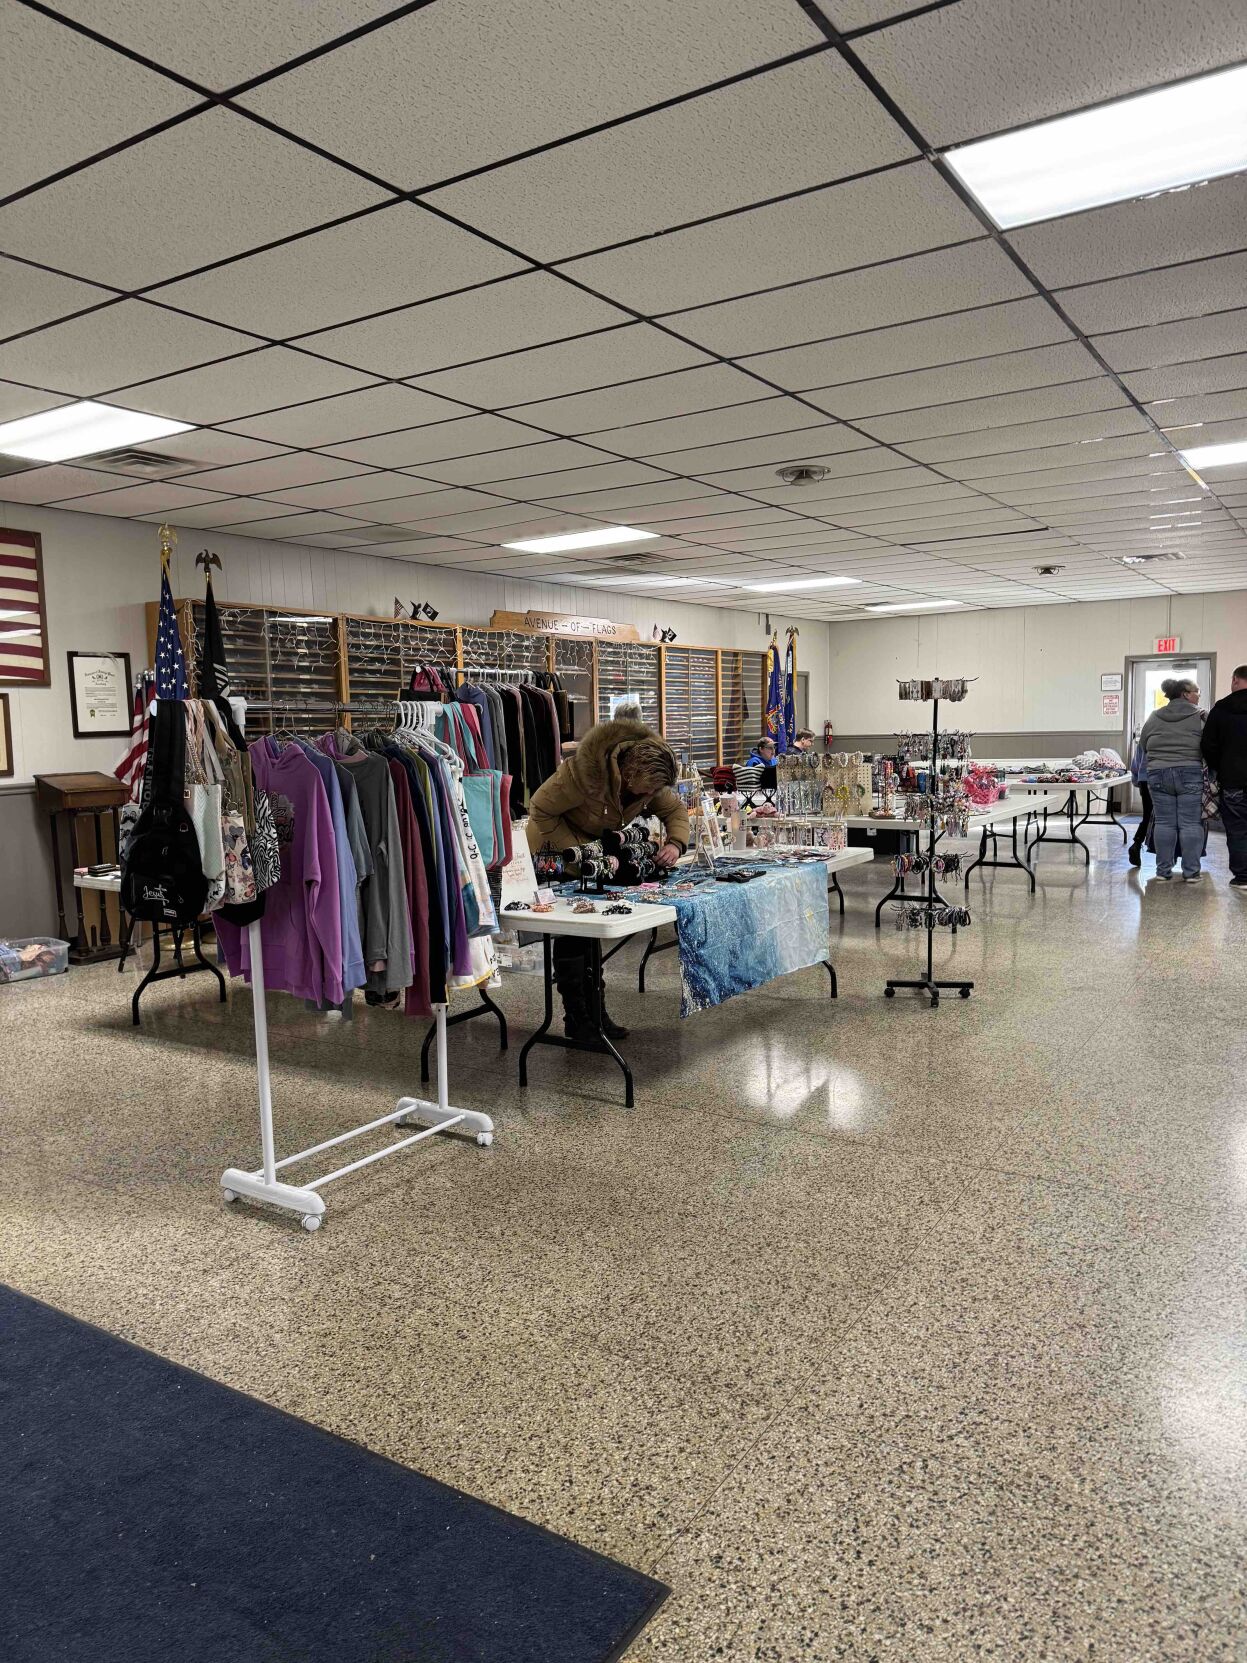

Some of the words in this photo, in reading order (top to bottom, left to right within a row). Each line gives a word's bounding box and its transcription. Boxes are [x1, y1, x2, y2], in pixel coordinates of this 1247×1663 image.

[524, 617, 559, 630] AVENUE
[570, 621, 581, 632] OF
[592, 623, 617, 635] FLAGS
[1157, 638, 1176, 652] EXIT
